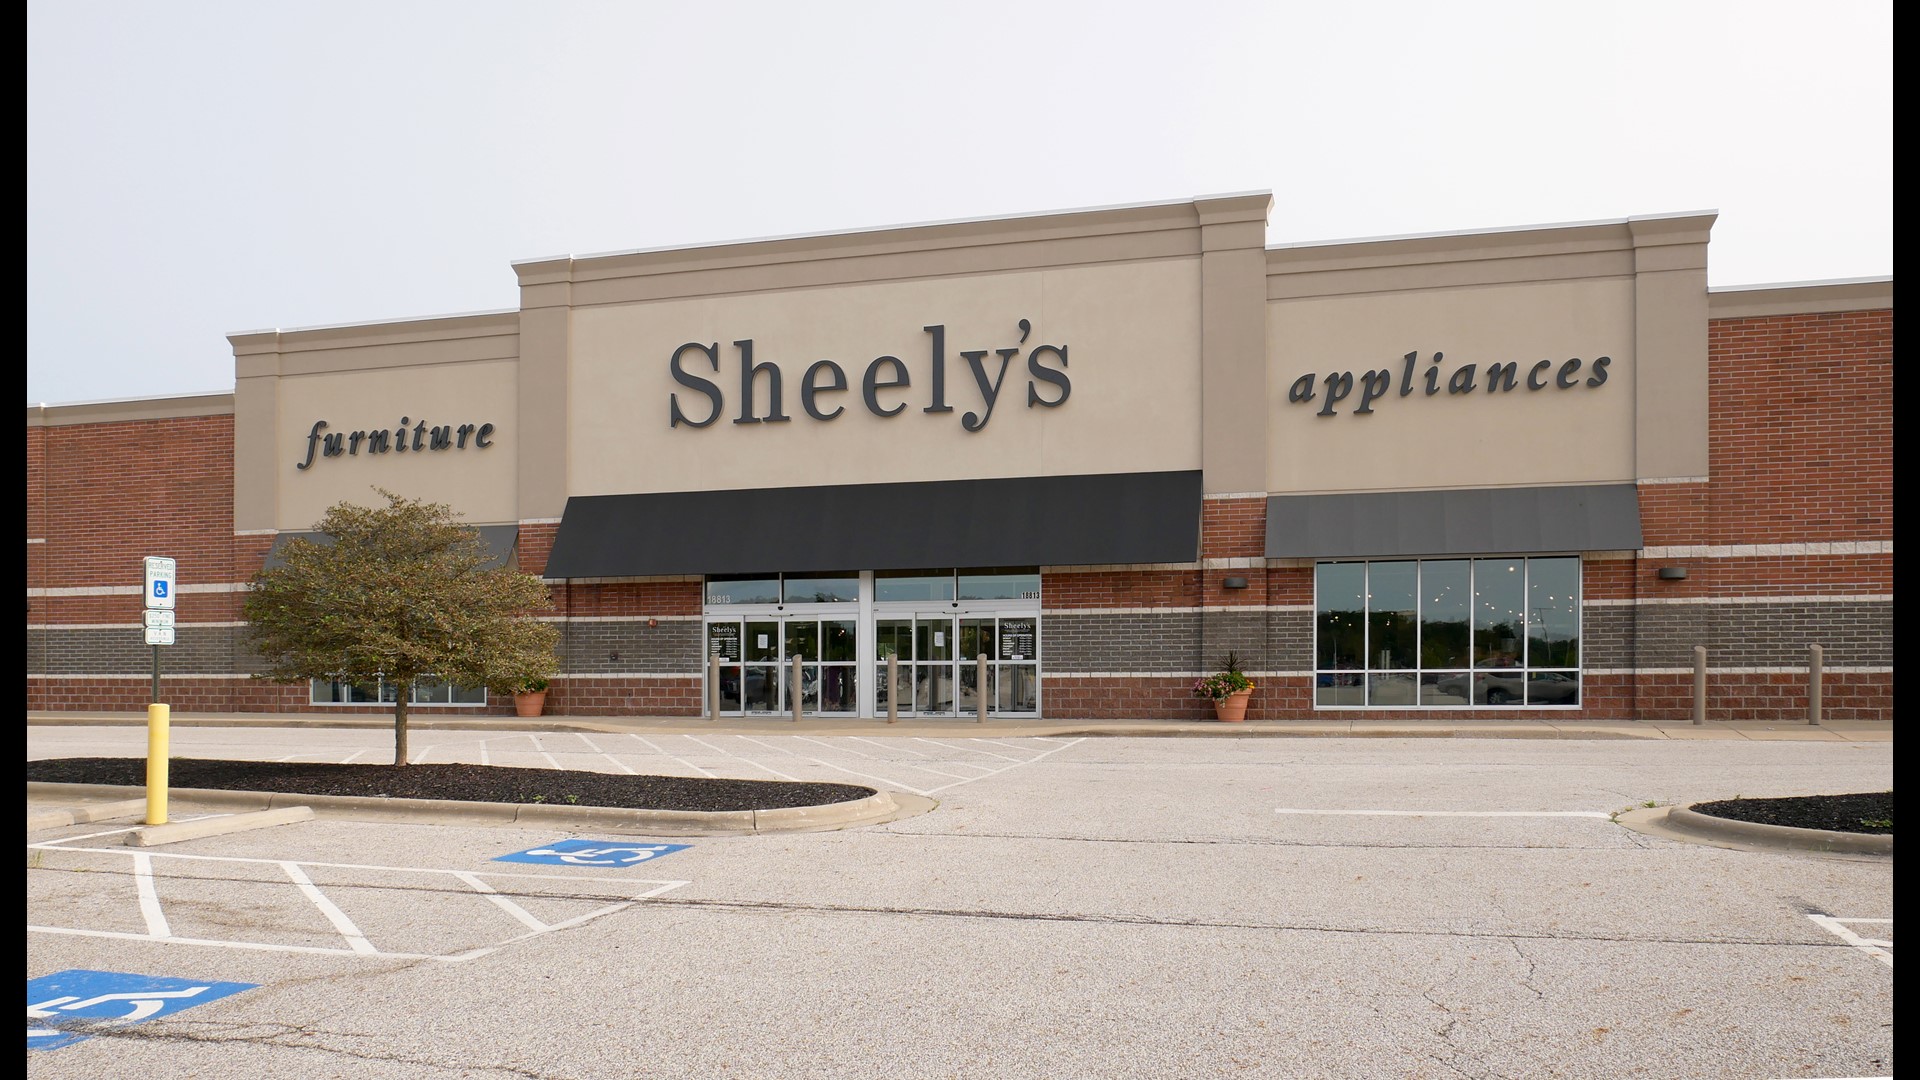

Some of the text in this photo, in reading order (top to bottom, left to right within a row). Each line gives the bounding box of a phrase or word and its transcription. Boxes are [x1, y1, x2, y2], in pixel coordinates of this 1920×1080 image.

[669, 318, 1073, 434] Sheely's
[1287, 350, 1613, 419] appliances
[296, 416, 495, 472] furniture
[148, 562, 173, 570] RESERVED
[707, 595, 731, 603] 18813
